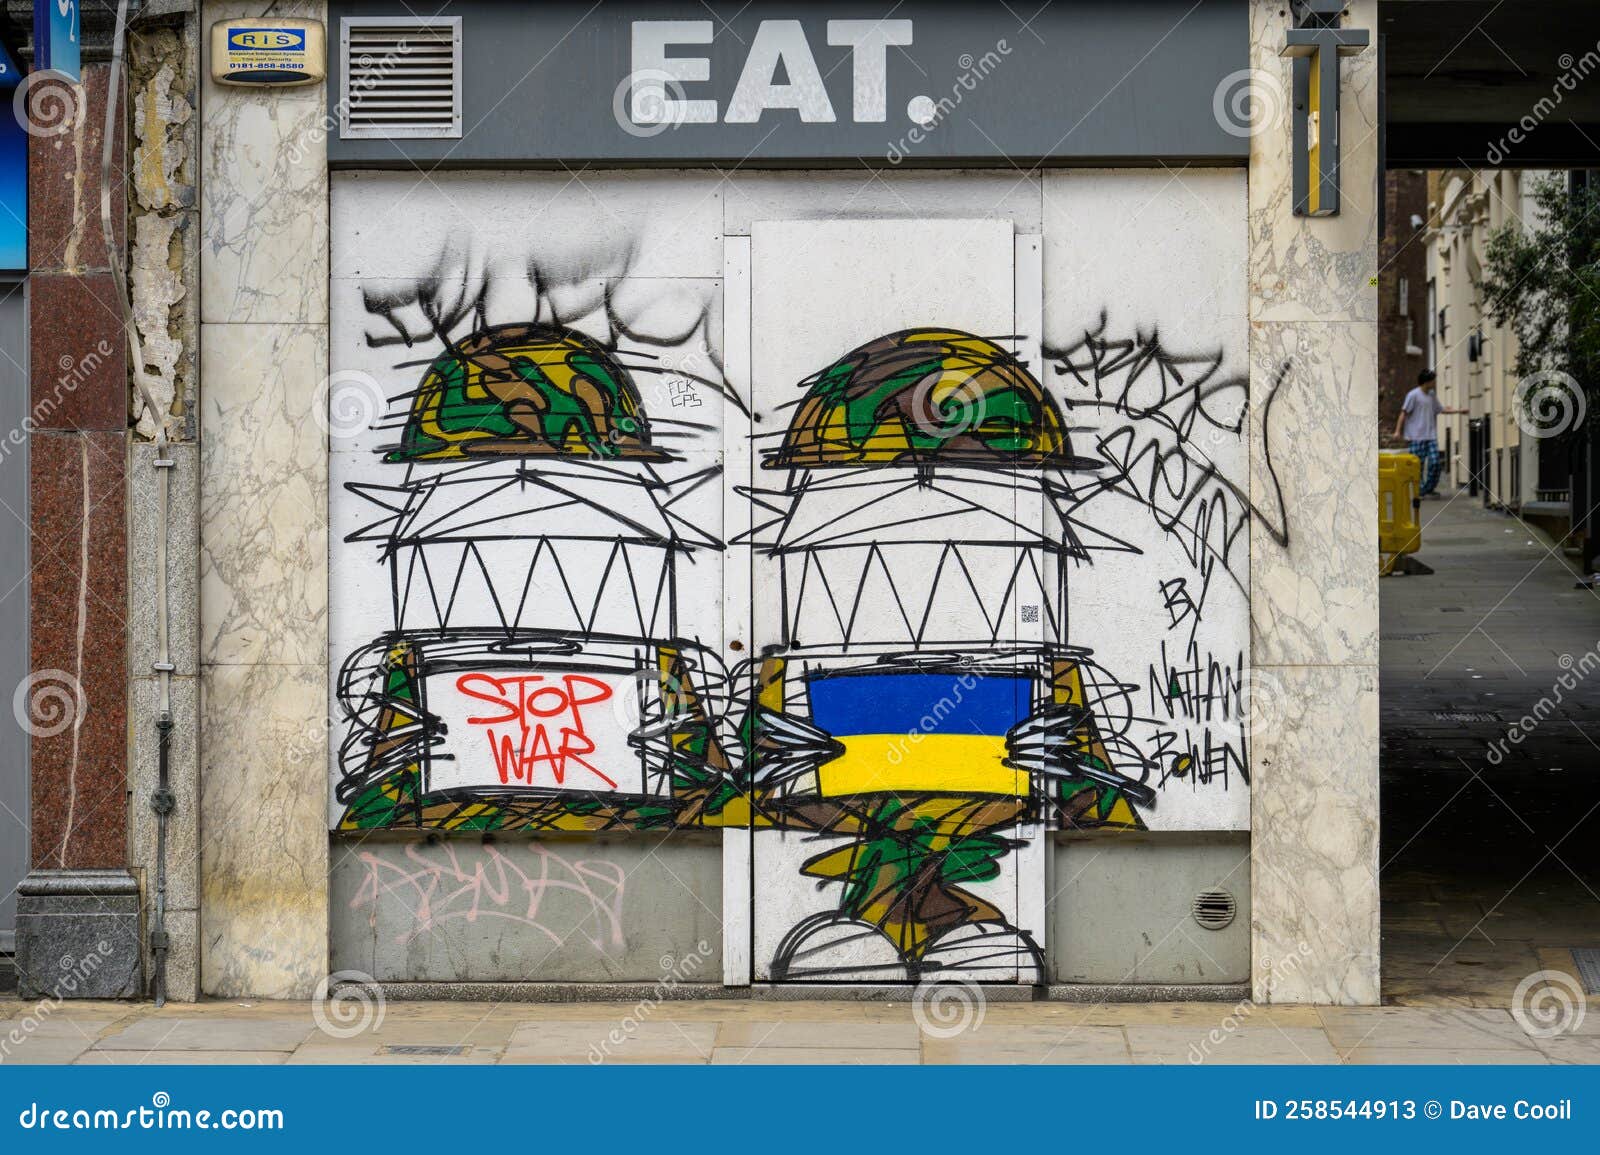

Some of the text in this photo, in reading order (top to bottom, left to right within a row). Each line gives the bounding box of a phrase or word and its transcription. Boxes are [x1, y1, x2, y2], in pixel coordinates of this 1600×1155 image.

[243, 35, 290, 45] RIS
[631, 19, 937, 125] EAT.
[456, 673, 613, 735] STOP
[1150, 639, 1246, 724] NATHAN
[487, 723, 618, 789] WAR
